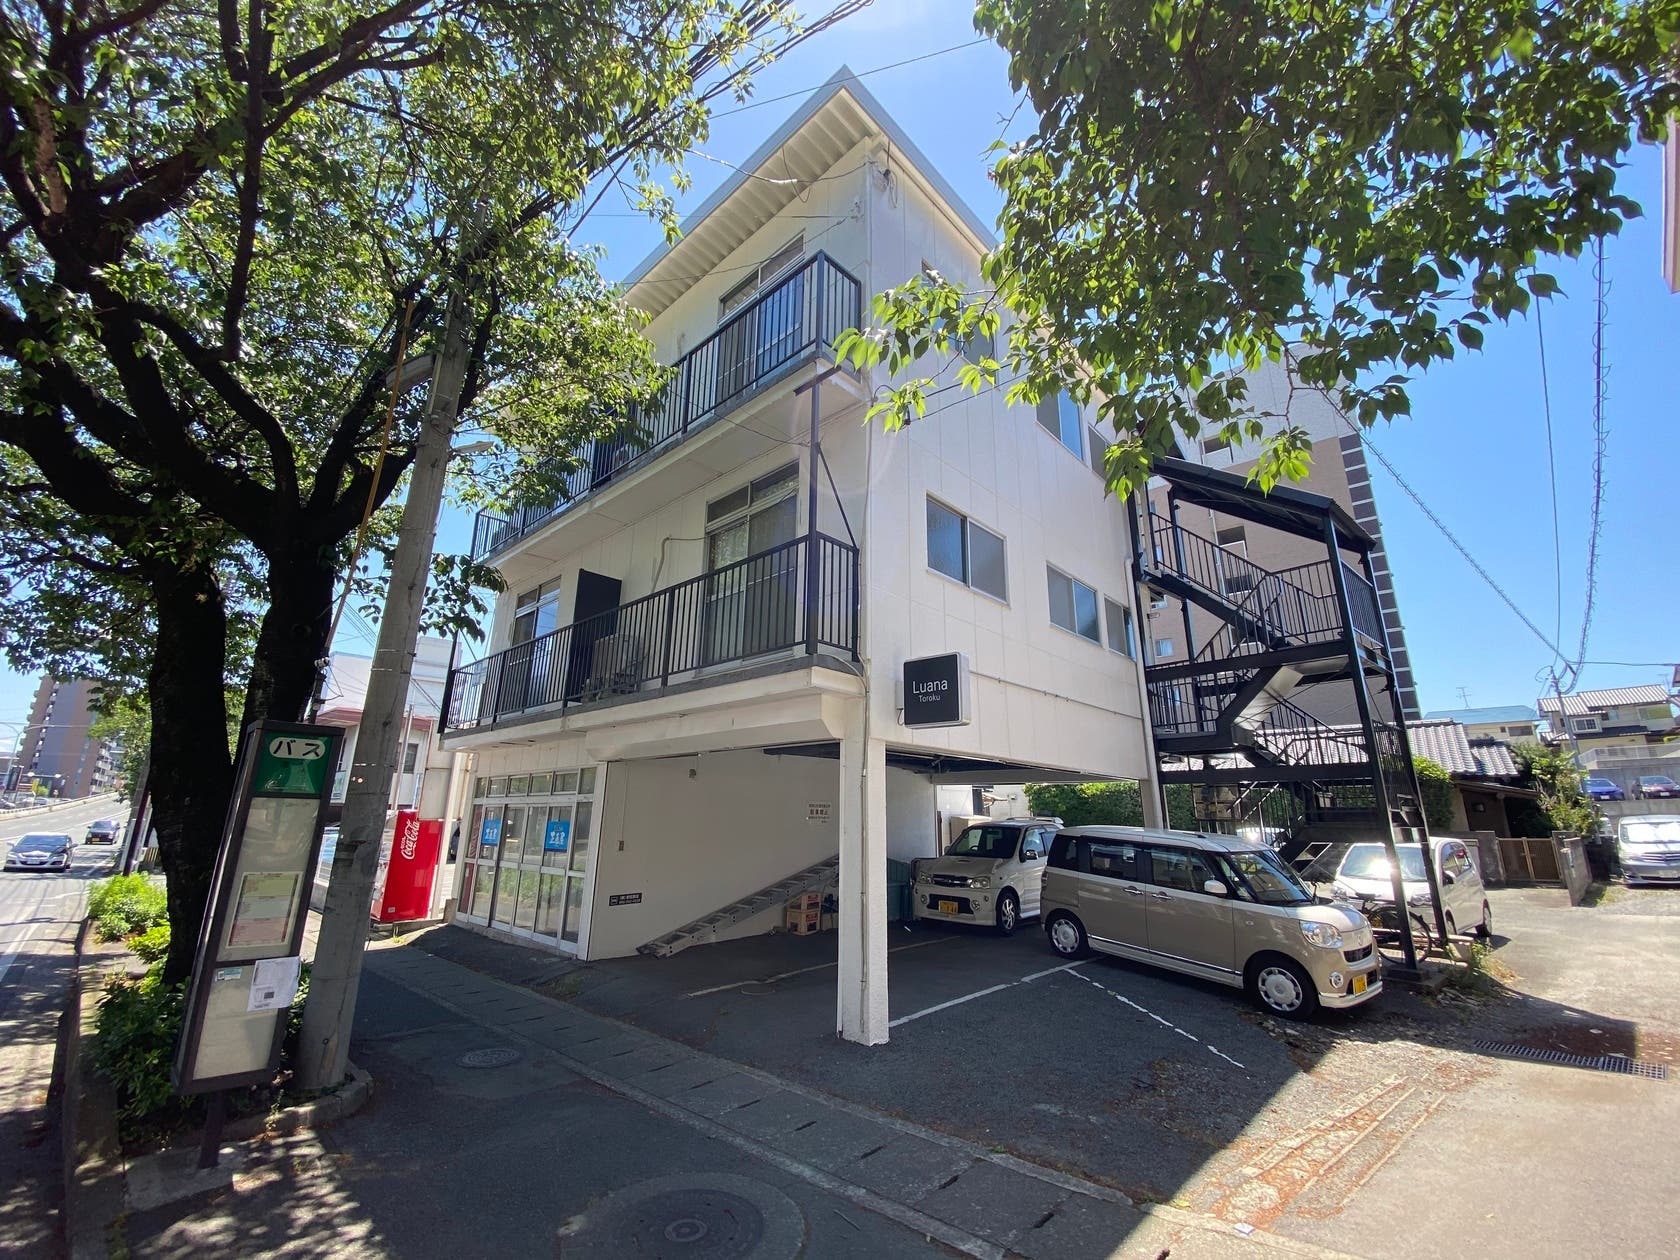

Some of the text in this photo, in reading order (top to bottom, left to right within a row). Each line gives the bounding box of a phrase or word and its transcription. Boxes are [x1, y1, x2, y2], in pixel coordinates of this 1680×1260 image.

[912, 680, 948, 694] Luana
[919, 694, 941, 703] Toroku
[273, 739, 320, 757] バス
